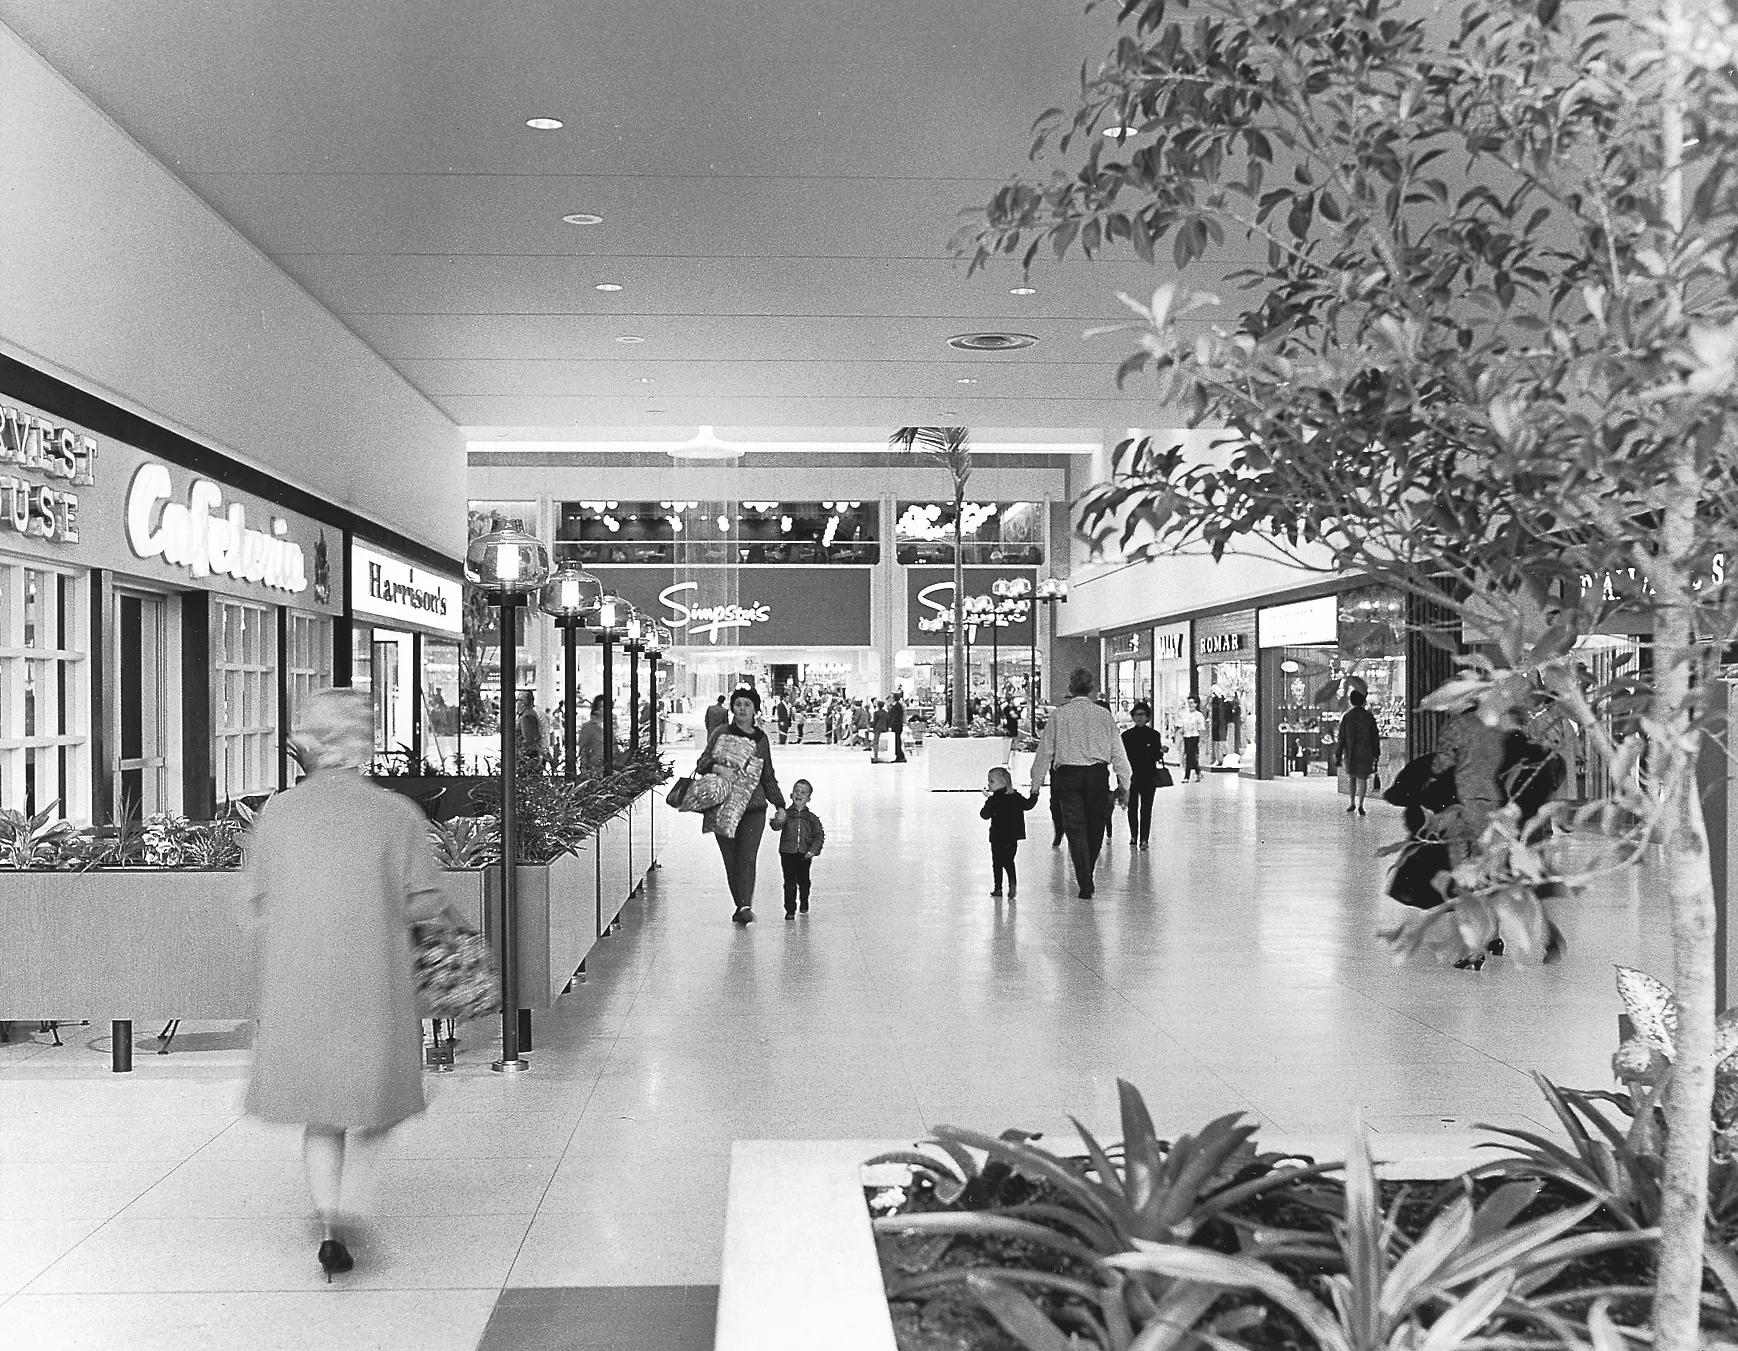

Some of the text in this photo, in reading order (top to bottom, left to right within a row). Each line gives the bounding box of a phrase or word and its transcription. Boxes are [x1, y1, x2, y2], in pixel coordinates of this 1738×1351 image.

[124, 461, 308, 593] Cafeteria
[368, 560, 447, 616] Harrison's
[658, 581, 771, 644] Simpson's
[1200, 633, 1242, 653] ROMAR
